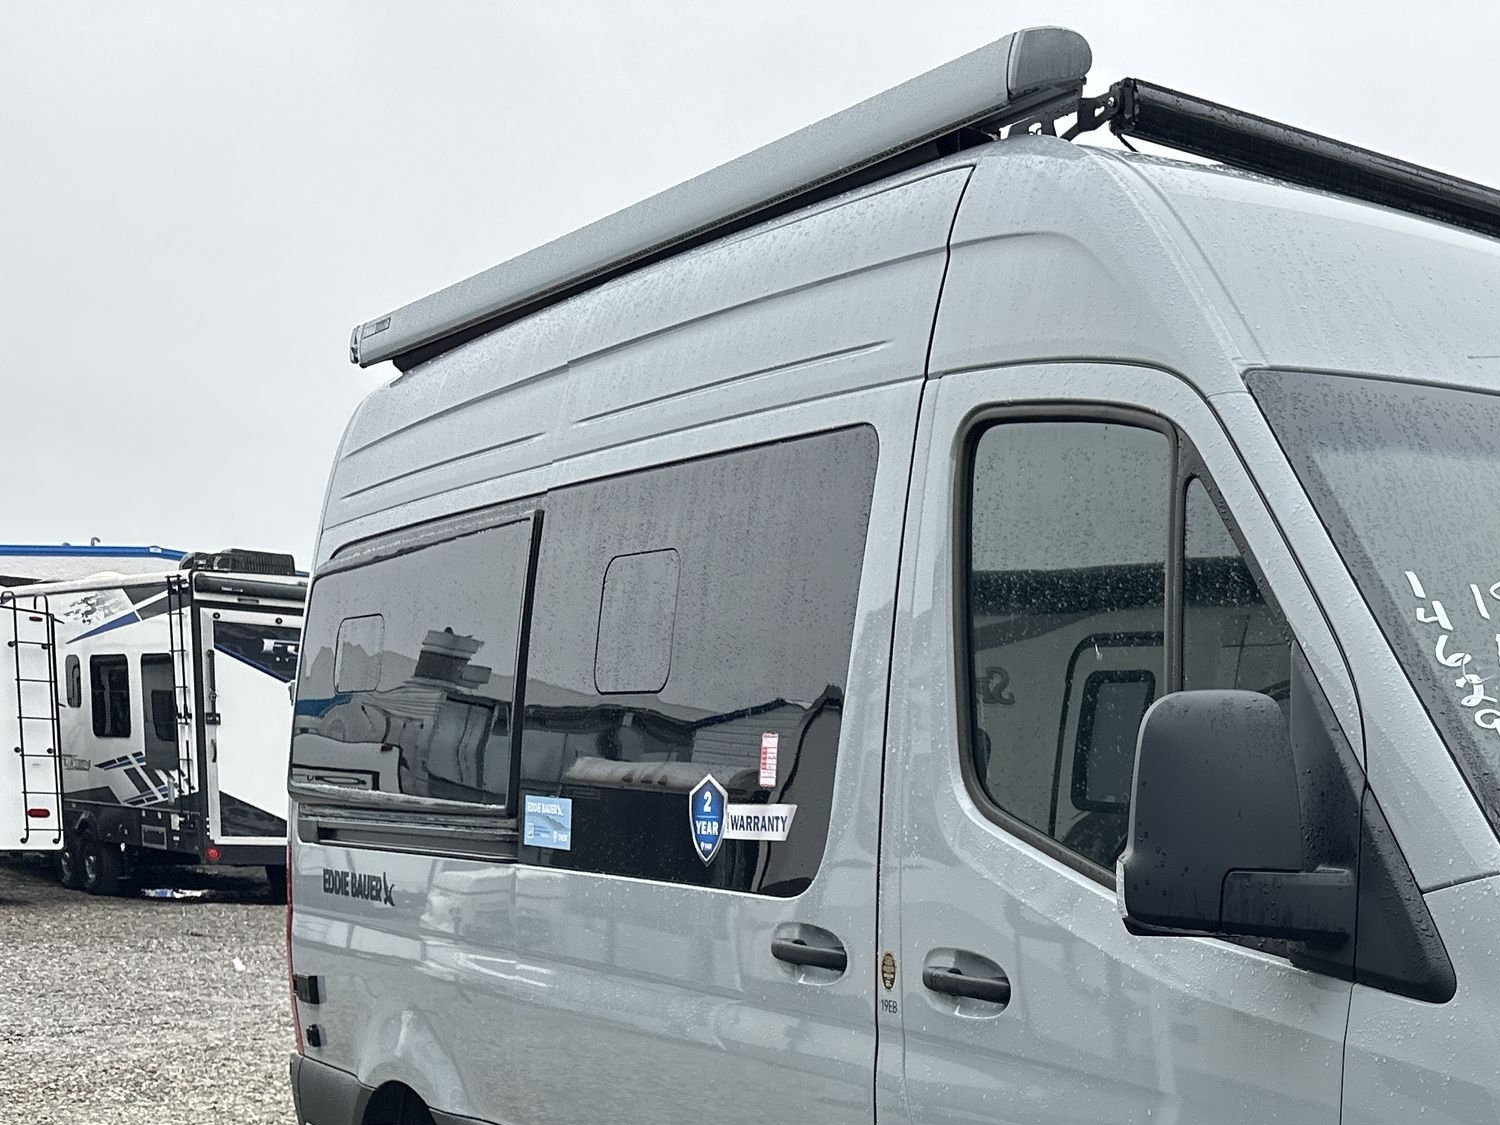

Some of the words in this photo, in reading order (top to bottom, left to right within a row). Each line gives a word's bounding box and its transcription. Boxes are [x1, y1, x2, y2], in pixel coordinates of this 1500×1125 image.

[703, 790, 712, 813] 2
[695, 820, 719, 836] YEAR
[730, 814, 788, 833] WARRANTY
[323, 868, 350, 897] EDDIE
[351, 872, 383, 902] BAUER
[881, 999, 898, 1014] 19EB
